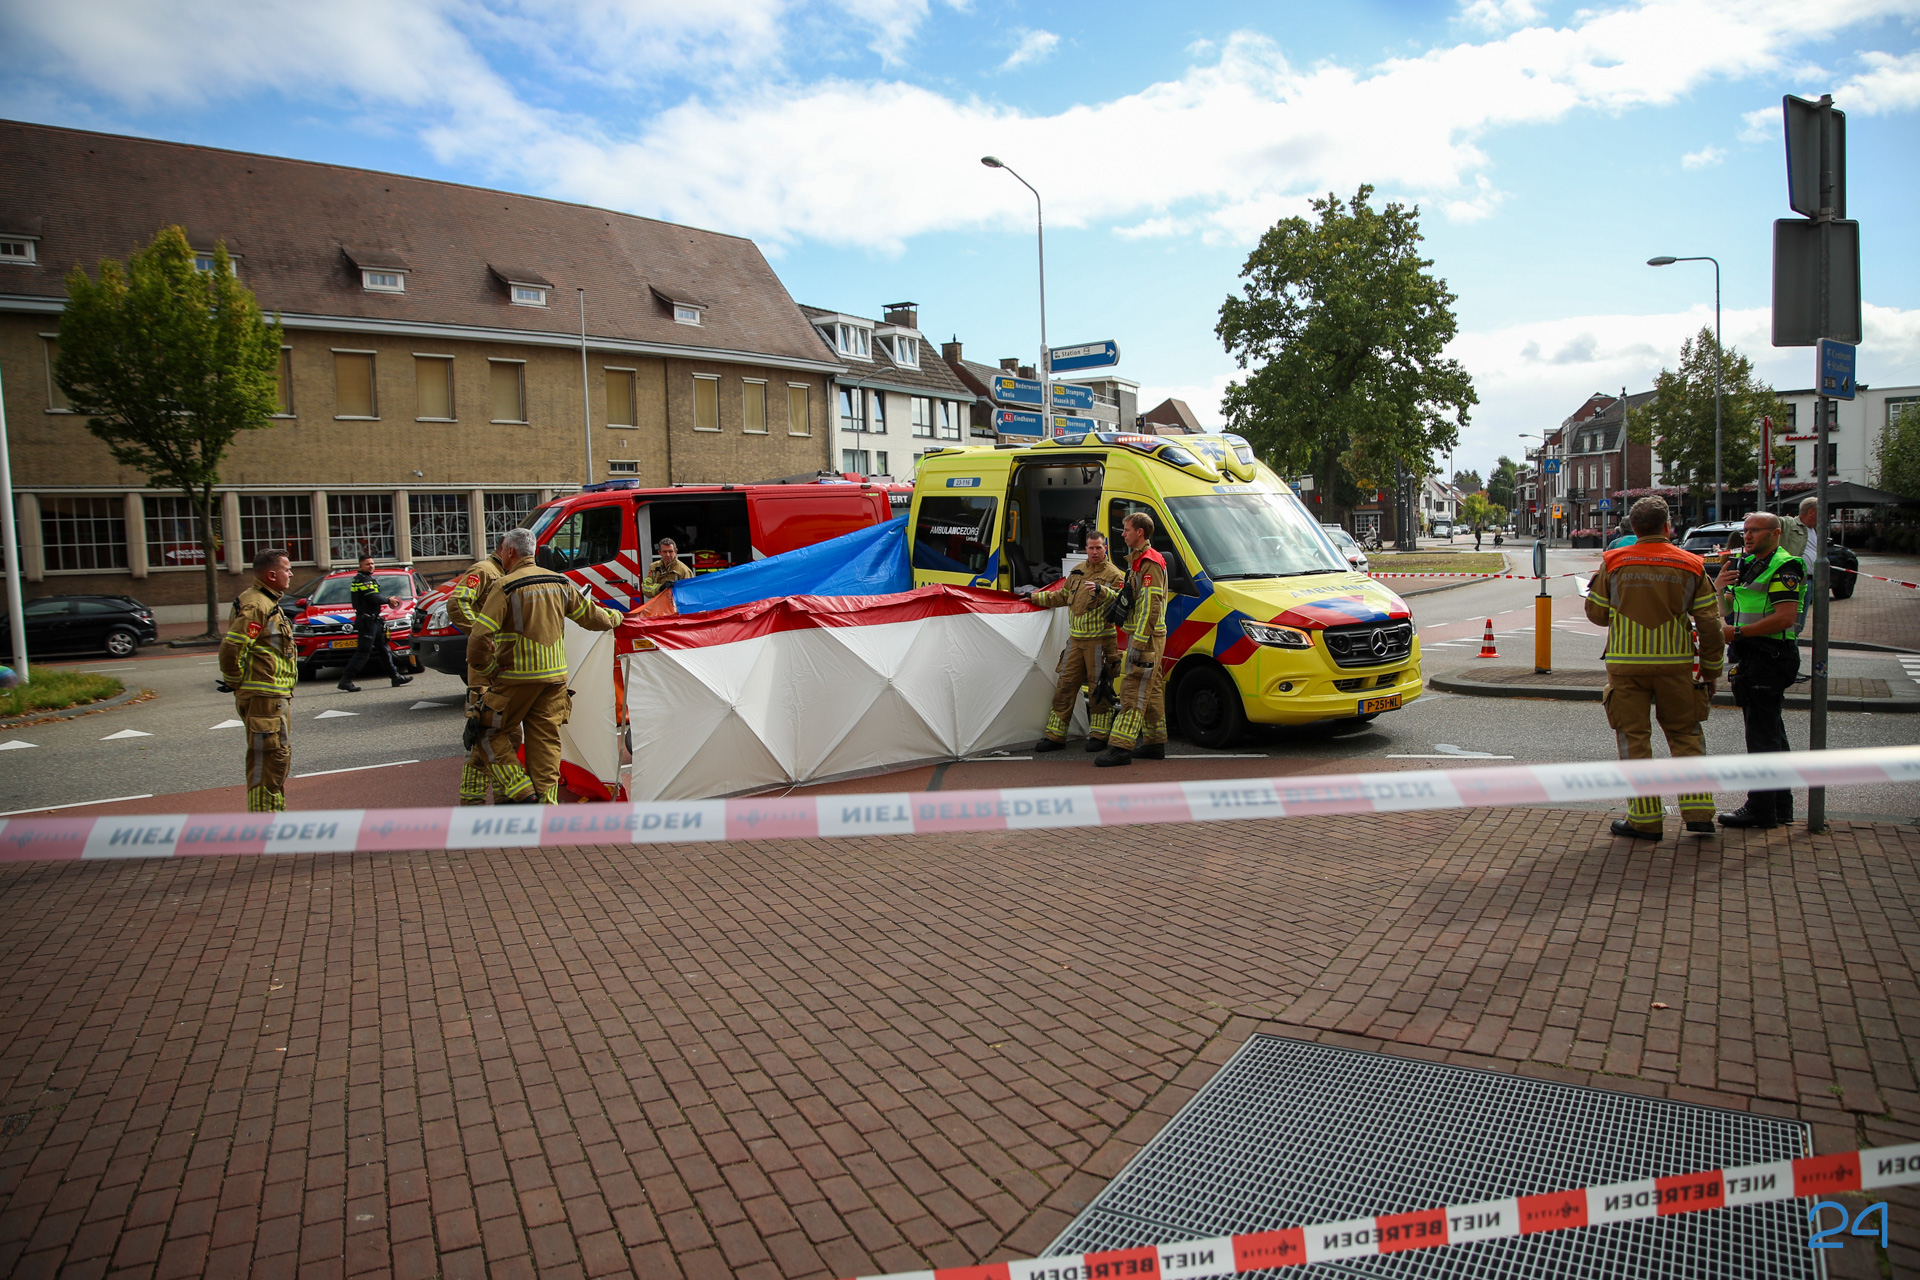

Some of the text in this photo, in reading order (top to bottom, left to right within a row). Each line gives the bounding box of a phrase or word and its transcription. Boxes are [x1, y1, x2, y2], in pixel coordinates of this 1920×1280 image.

[1061, 349, 1081, 357] Station
[1002, 380, 1041, 391] N275 Nederweert
[1002, 390, 1015, 398] Venlo
[1065, 388, 1085, 398] Stramproy
[1053, 397, 1069, 405] Maaseik
[1014, 414, 1036, 423] Eindhoven
[1066, 420, 1086, 428] Roermond
[930, 526, 980, 535] AMBULANCEZORG
[1621, 572, 1682, 584] BRANDWEER
[1367, 697, 1398, 711] P-251-NL
